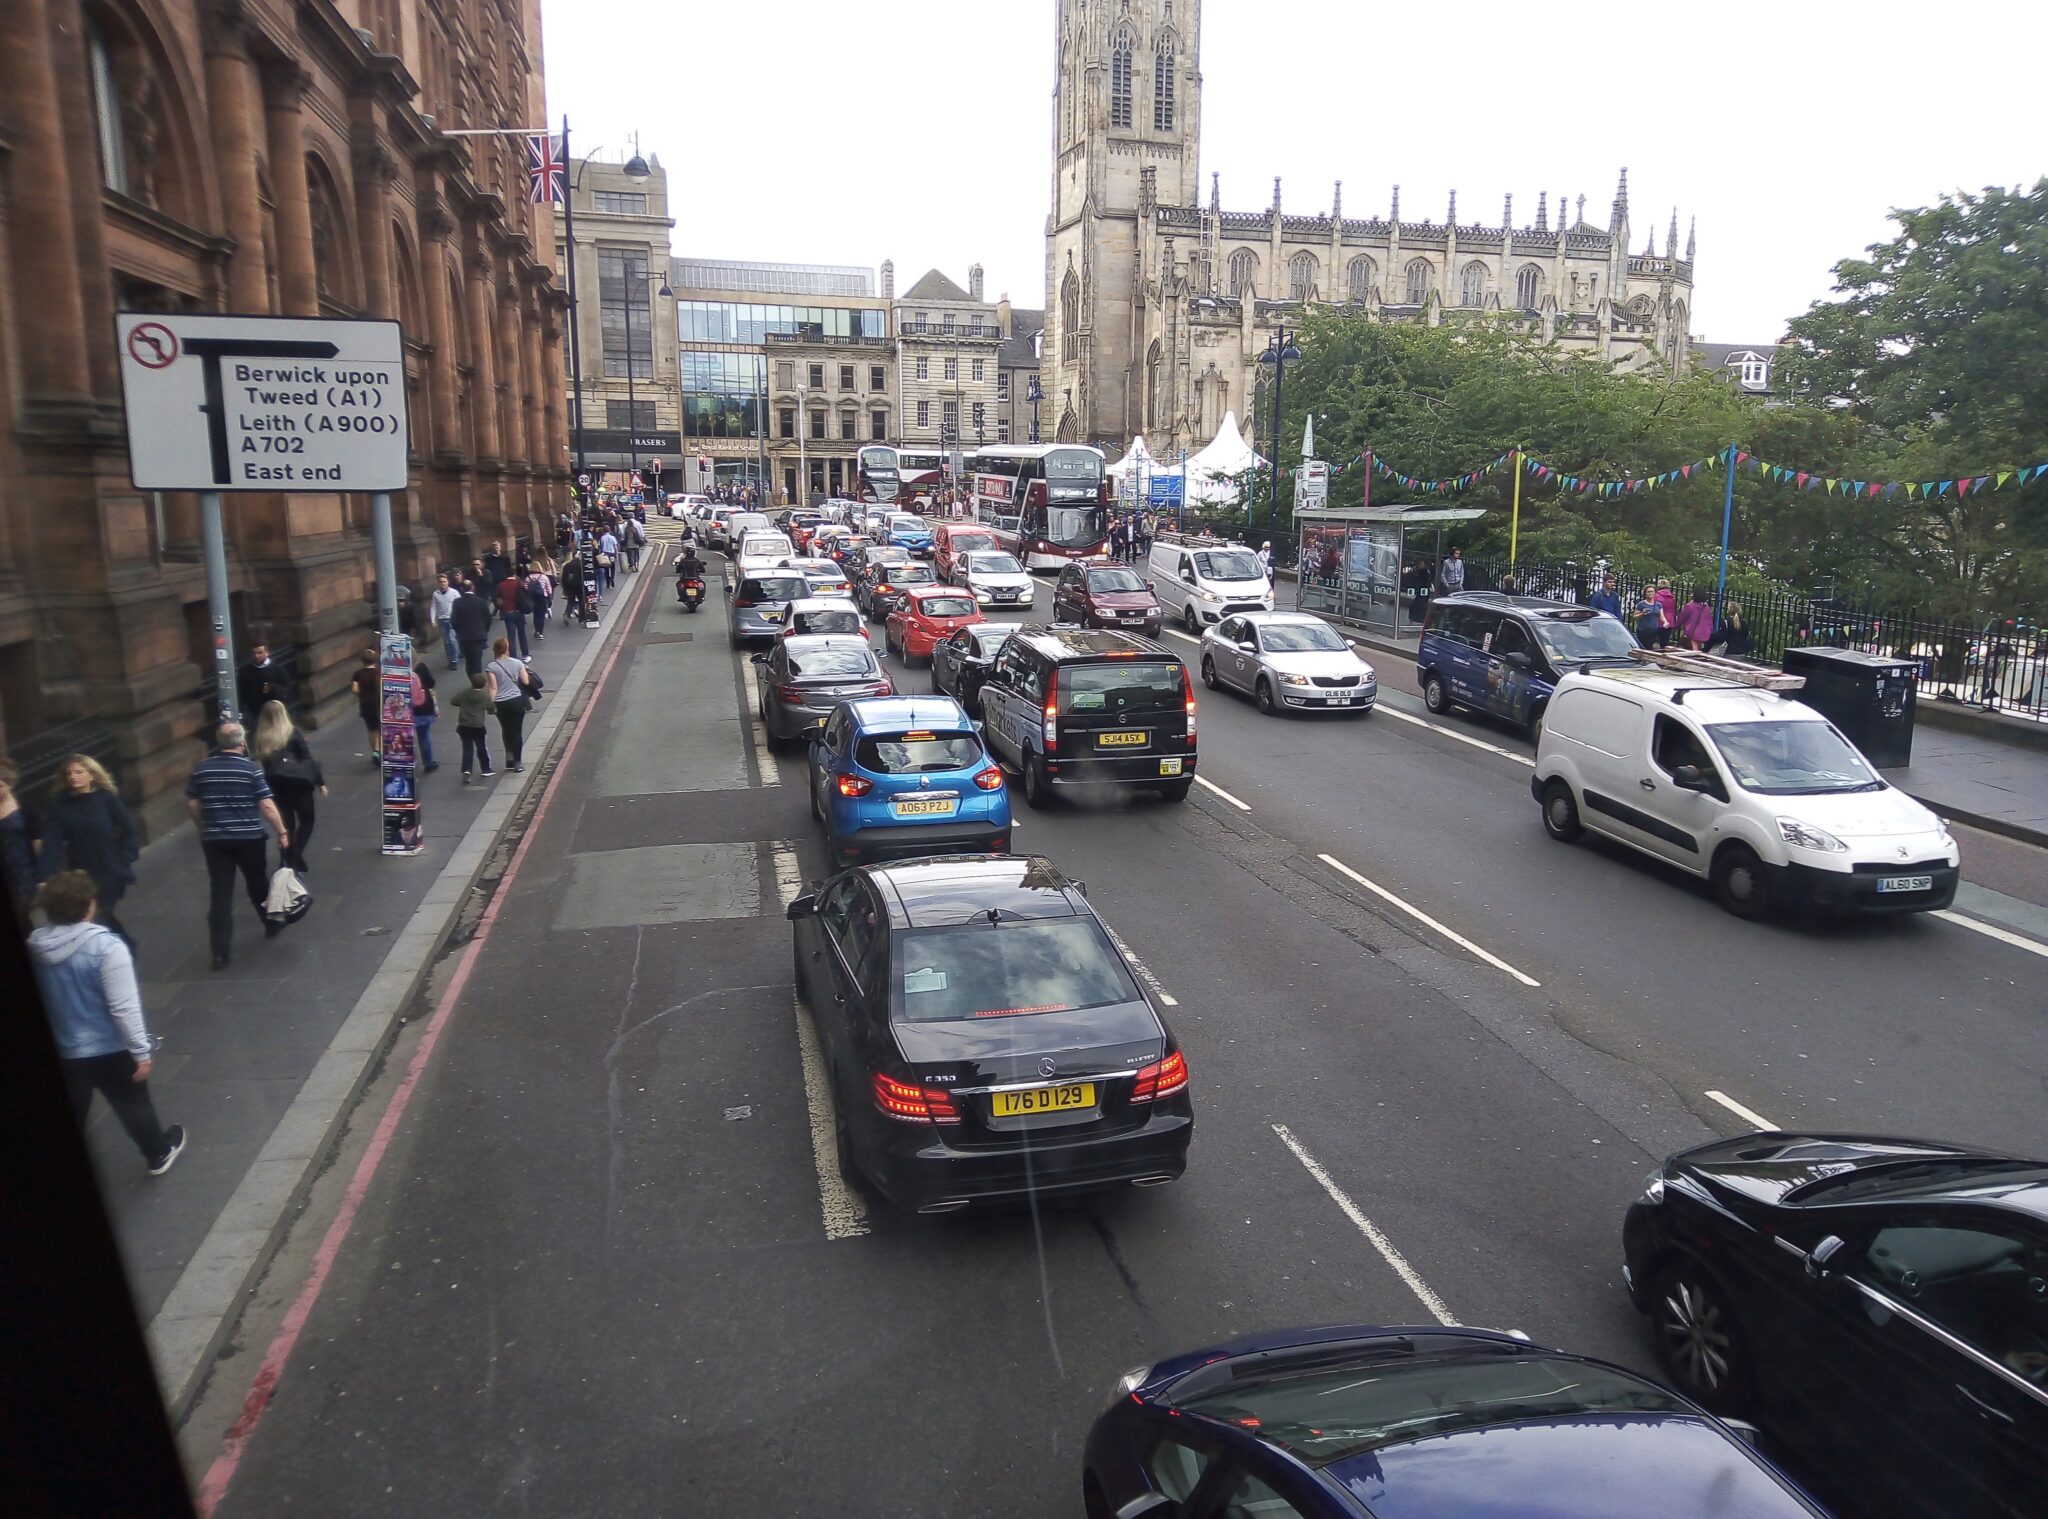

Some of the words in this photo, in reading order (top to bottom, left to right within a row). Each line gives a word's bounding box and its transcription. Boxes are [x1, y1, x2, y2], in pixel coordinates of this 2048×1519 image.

[235, 365, 327, 384] Berwick
[335, 370, 389, 385] upon
[244, 387, 318, 406] Tweed
[327, 387, 382, 408] (A1)
[239, 414, 296, 432] Leith
[304, 413, 399, 435] (A900)
[241, 437, 305, 454] A702
[244, 463, 294, 481] East
[303, 464, 342, 481] end
[1086, 489, 1097, 498] 22
[1125, 734, 1140, 742] ASX
[930, 802, 949, 811] PZJ
[1004, 1091, 1033, 1112] 176
[1039, 1090, 1050, 1108] D
[1053, 1086, 1083, 1106] 129
